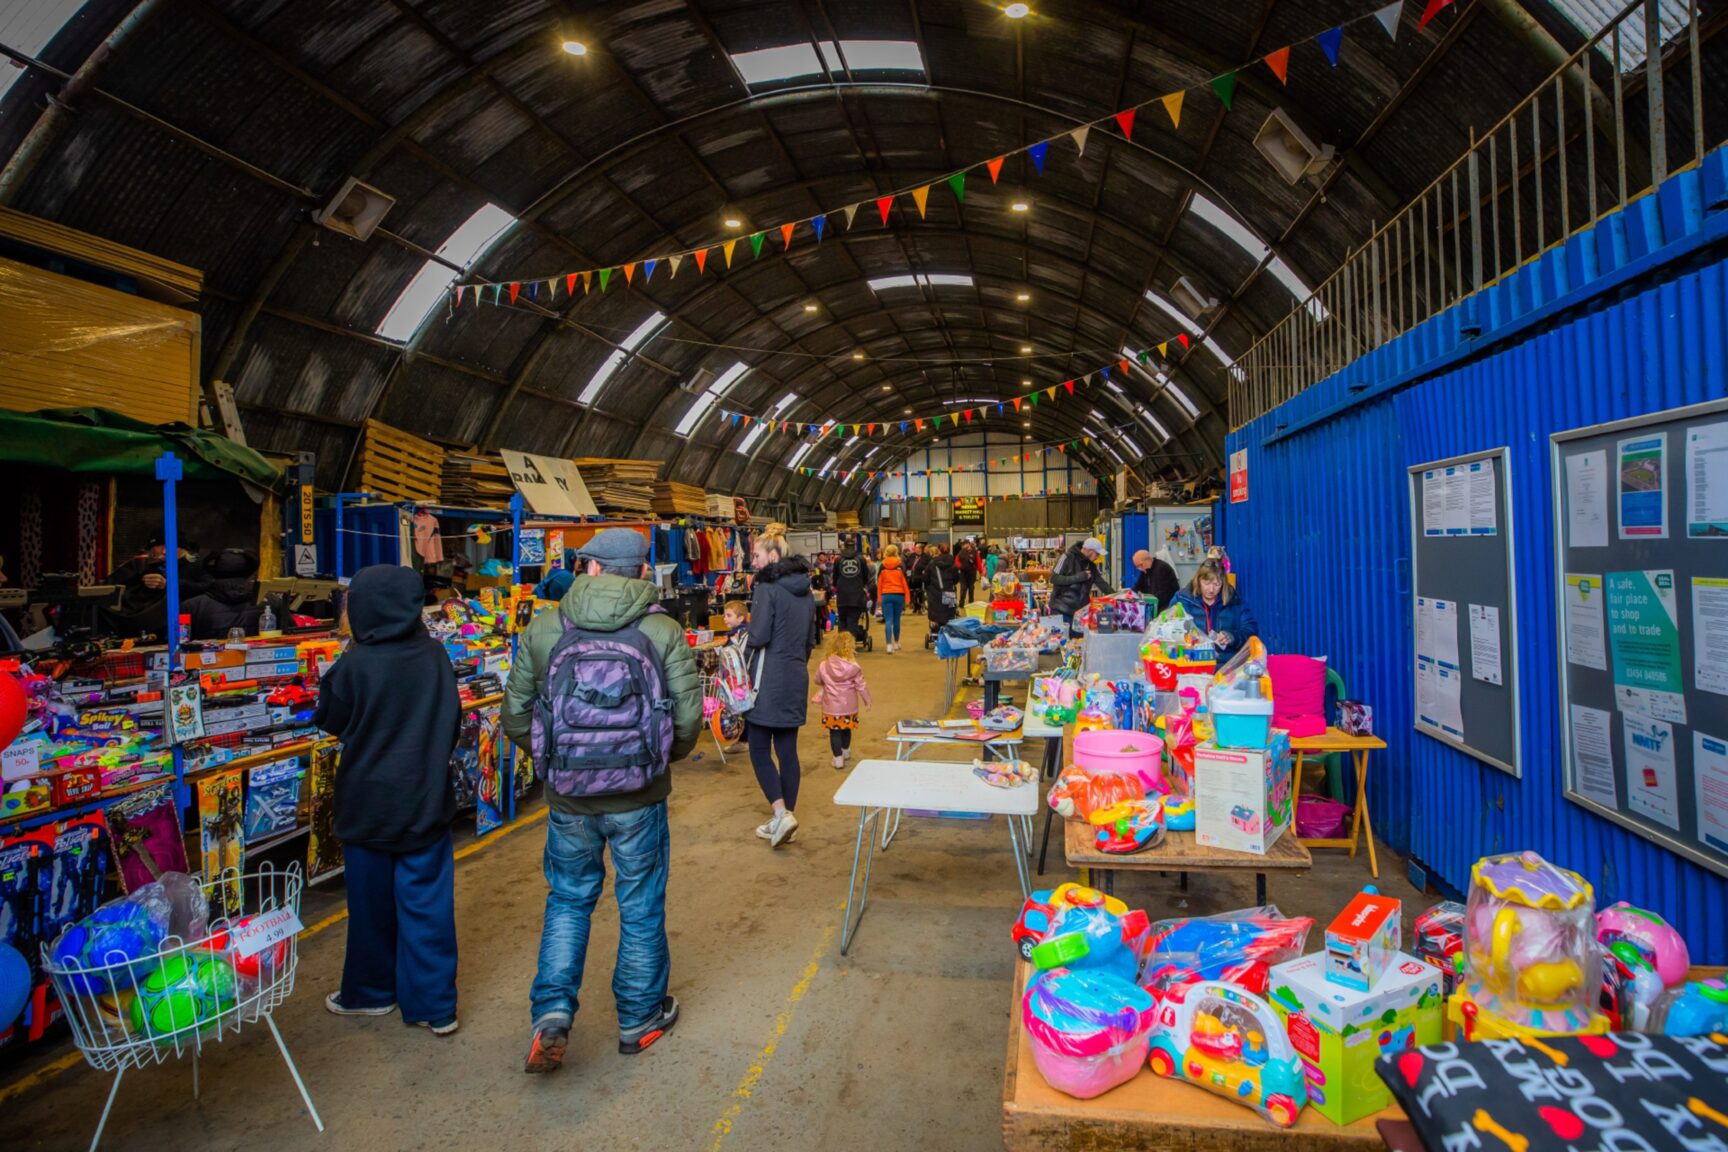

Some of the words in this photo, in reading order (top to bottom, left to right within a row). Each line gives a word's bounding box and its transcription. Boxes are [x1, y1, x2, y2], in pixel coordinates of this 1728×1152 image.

[303, 491, 311, 504] 20
[303, 508, 311, 520] TS
[303, 522, 311, 536] 50
[1609, 578, 1615, 588] A
[1610, 594, 1623, 605] fair
[1625, 594, 1648, 606] place
[1611, 609, 1619, 619] to
[1620, 610, 1640, 621] shop
[1613, 624, 1627, 634] and
[1628, 625, 1637, 634] to
[1639, 625, 1661, 636] trade
[80, 711, 124, 726] Spikey
[92, 722, 112, 731] Ball
[1632, 732, 1662, 752] NMTF
[3, 748, 35, 758] SNAPS
[266, 928, 284, 942] 4.99
